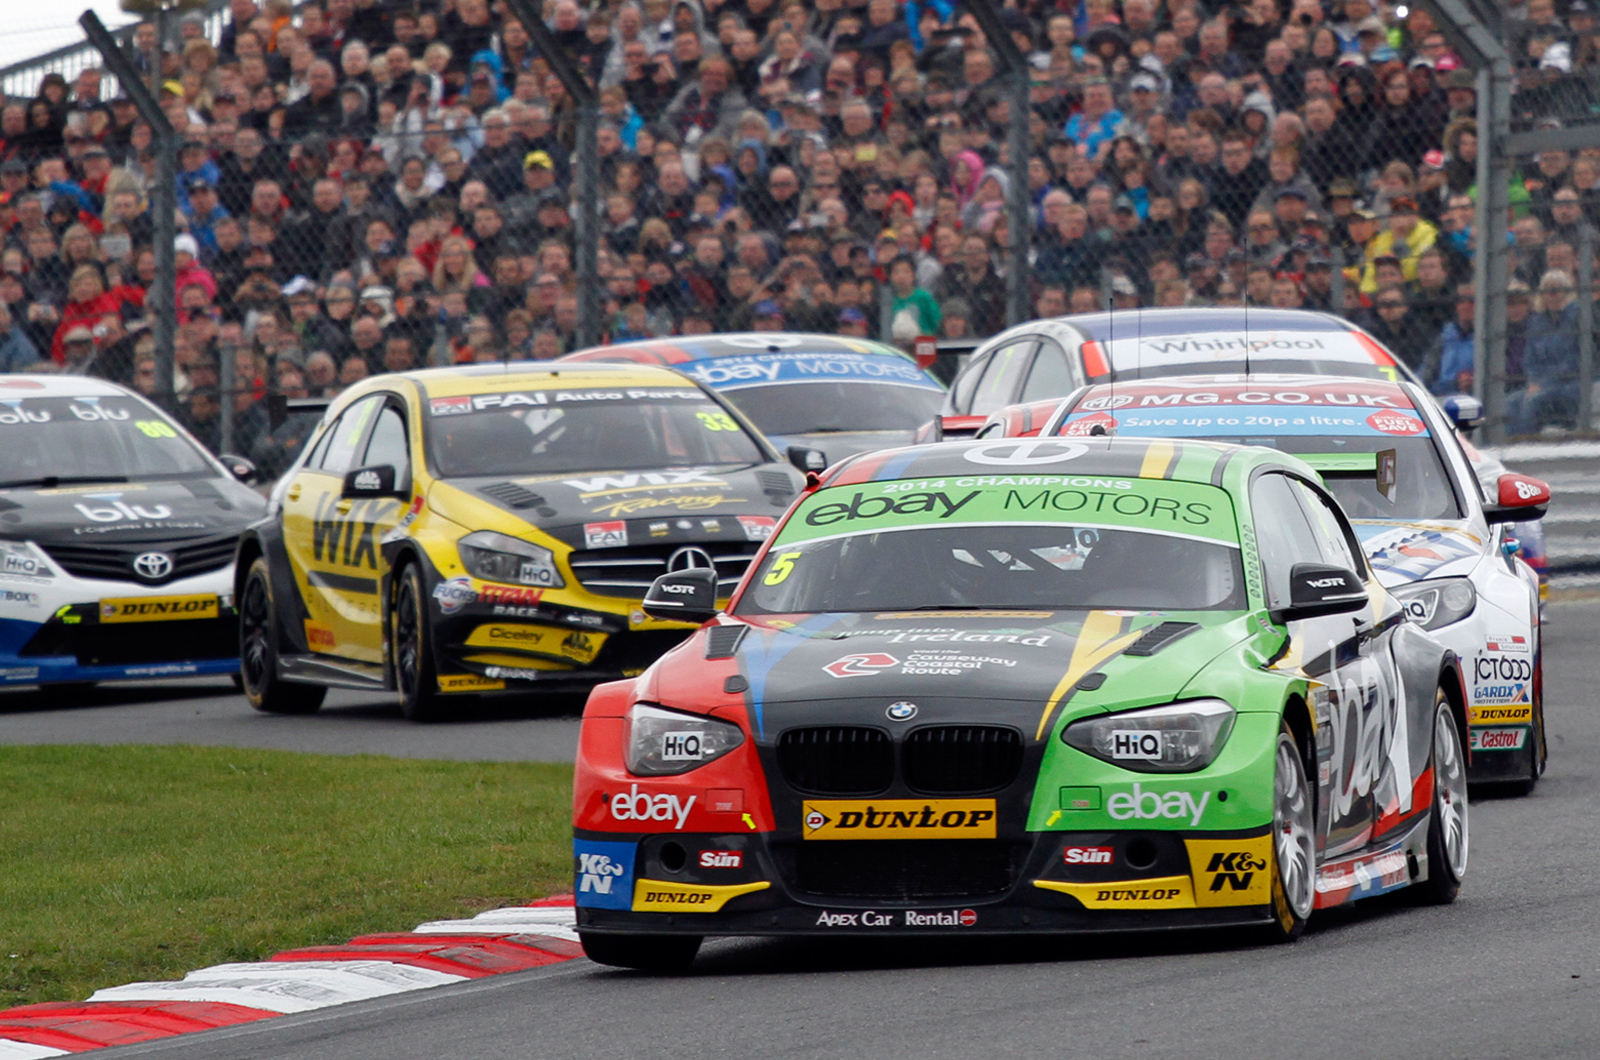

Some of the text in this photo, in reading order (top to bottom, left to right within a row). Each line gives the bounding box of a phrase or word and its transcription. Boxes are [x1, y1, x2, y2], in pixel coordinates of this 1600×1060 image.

[1149, 338, 1325, 354] Whirlpool
[796, 360, 922, 381] MOTORS
[473, 390, 706, 410] FAI Auto Parts
[1140, 391, 1399, 408] MG.CO.UK
[69, 403, 130, 421] blu
[134, 420, 178, 438] 80
[695, 411, 740, 432] 33
[1123, 416, 1362, 430] Save up to 20p a litre.
[1374, 418, 1412, 427] FUEL
[1377, 423, 1420, 432] SAVE
[561, 469, 725, 493] WIX
[883, 476, 1133, 494] 2014 CHAMPIONS
[74, 501, 172, 522] blu
[805, 489, 1212, 527] ebay MOTORS
[312, 491, 398, 570] WIX
[590, 532, 625, 545] FAI
[748, 526, 773, 536] FA
[6, 557, 36, 572] HiQ
[763, 551, 801, 587] 5
[522, 568, 552, 582] HiQ
[436, 584, 478, 602] FUCHS
[478, 584, 545, 607] TITAN
[121, 600, 215, 615] DUNLOP
[493, 605, 539, 618] RACE
[1403, 601, 1427, 619] iQ
[489, 627, 543, 645] Ciceley
[887, 630, 1052, 648] Ireland
[903, 659, 982, 670] Coastal
[906, 653, 1018, 668] Causeway
[901, 666, 962, 676] Route
[1480, 708, 1530, 720] DUNLOP
[664, 736, 701, 756] HiQ
[1115, 734, 1160, 756] HiQ
[1481, 730, 1519, 749] Castrol
[611, 783, 697, 830] ebay
[1107, 782, 1211, 827] ebay
[834, 805, 994, 829] DUNLOP
[1205, 852, 1266, 872] K&
[1209, 872, 1254, 892] N
[645, 892, 712, 903] DUNLOP
[1096, 889, 1180, 901] DUNLOP
[861, 910, 893, 926] Car
